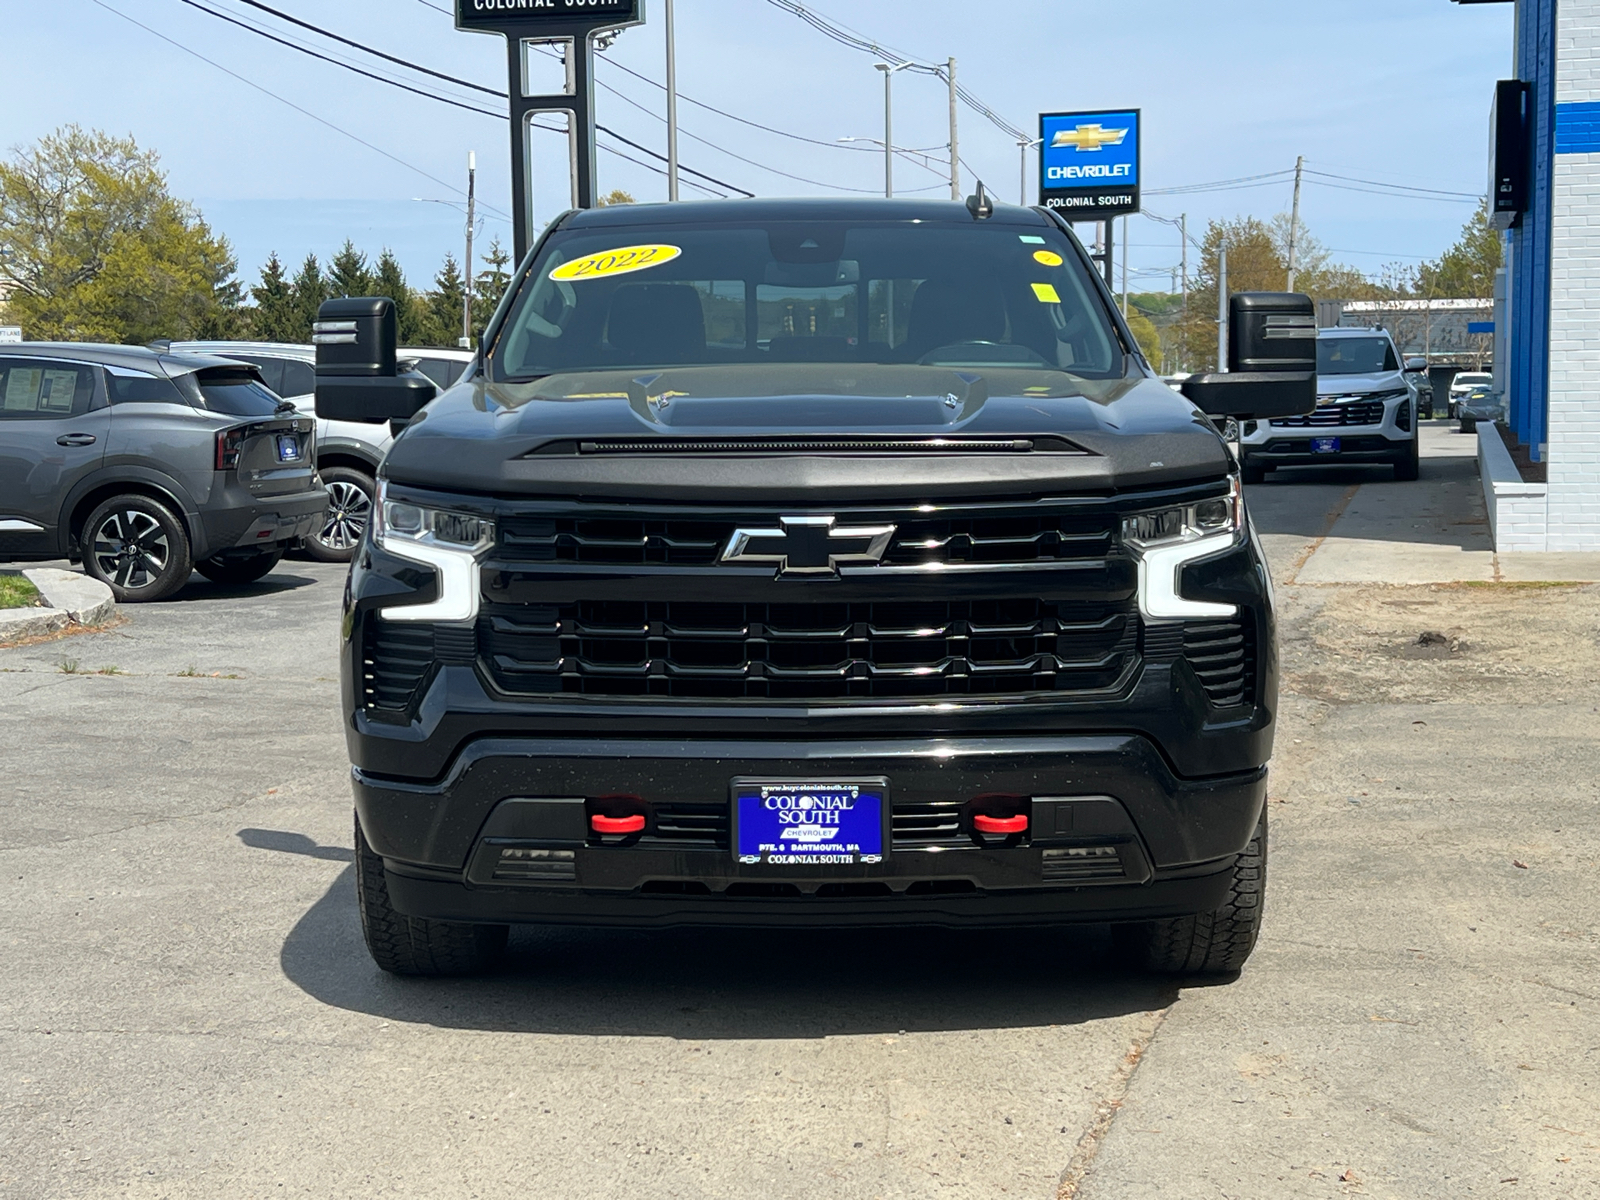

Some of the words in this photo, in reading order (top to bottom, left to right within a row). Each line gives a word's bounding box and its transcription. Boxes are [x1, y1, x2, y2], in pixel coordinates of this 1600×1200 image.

[1047, 164, 1132, 179] CHEVROLET
[1046, 197, 1095, 208] COLONIAL
[1098, 195, 1132, 206] SOUTH
[572, 248, 658, 276] 2022
[761, 785, 860, 793] www.buycolonialsouth.com
[765, 796, 853, 810] COLONIAL
[778, 810, 840, 824] SOUTH
[786, 829, 833, 837] CHEVROLET
[758, 844, 778, 852] RTE.
[779, 844, 785, 852] 6
[791, 844, 845, 853] DARTMOUTH,
[847, 844, 860, 852] MA
[767, 854, 819, 864] COLONIAL
[820, 854, 853, 864] SOUTH
